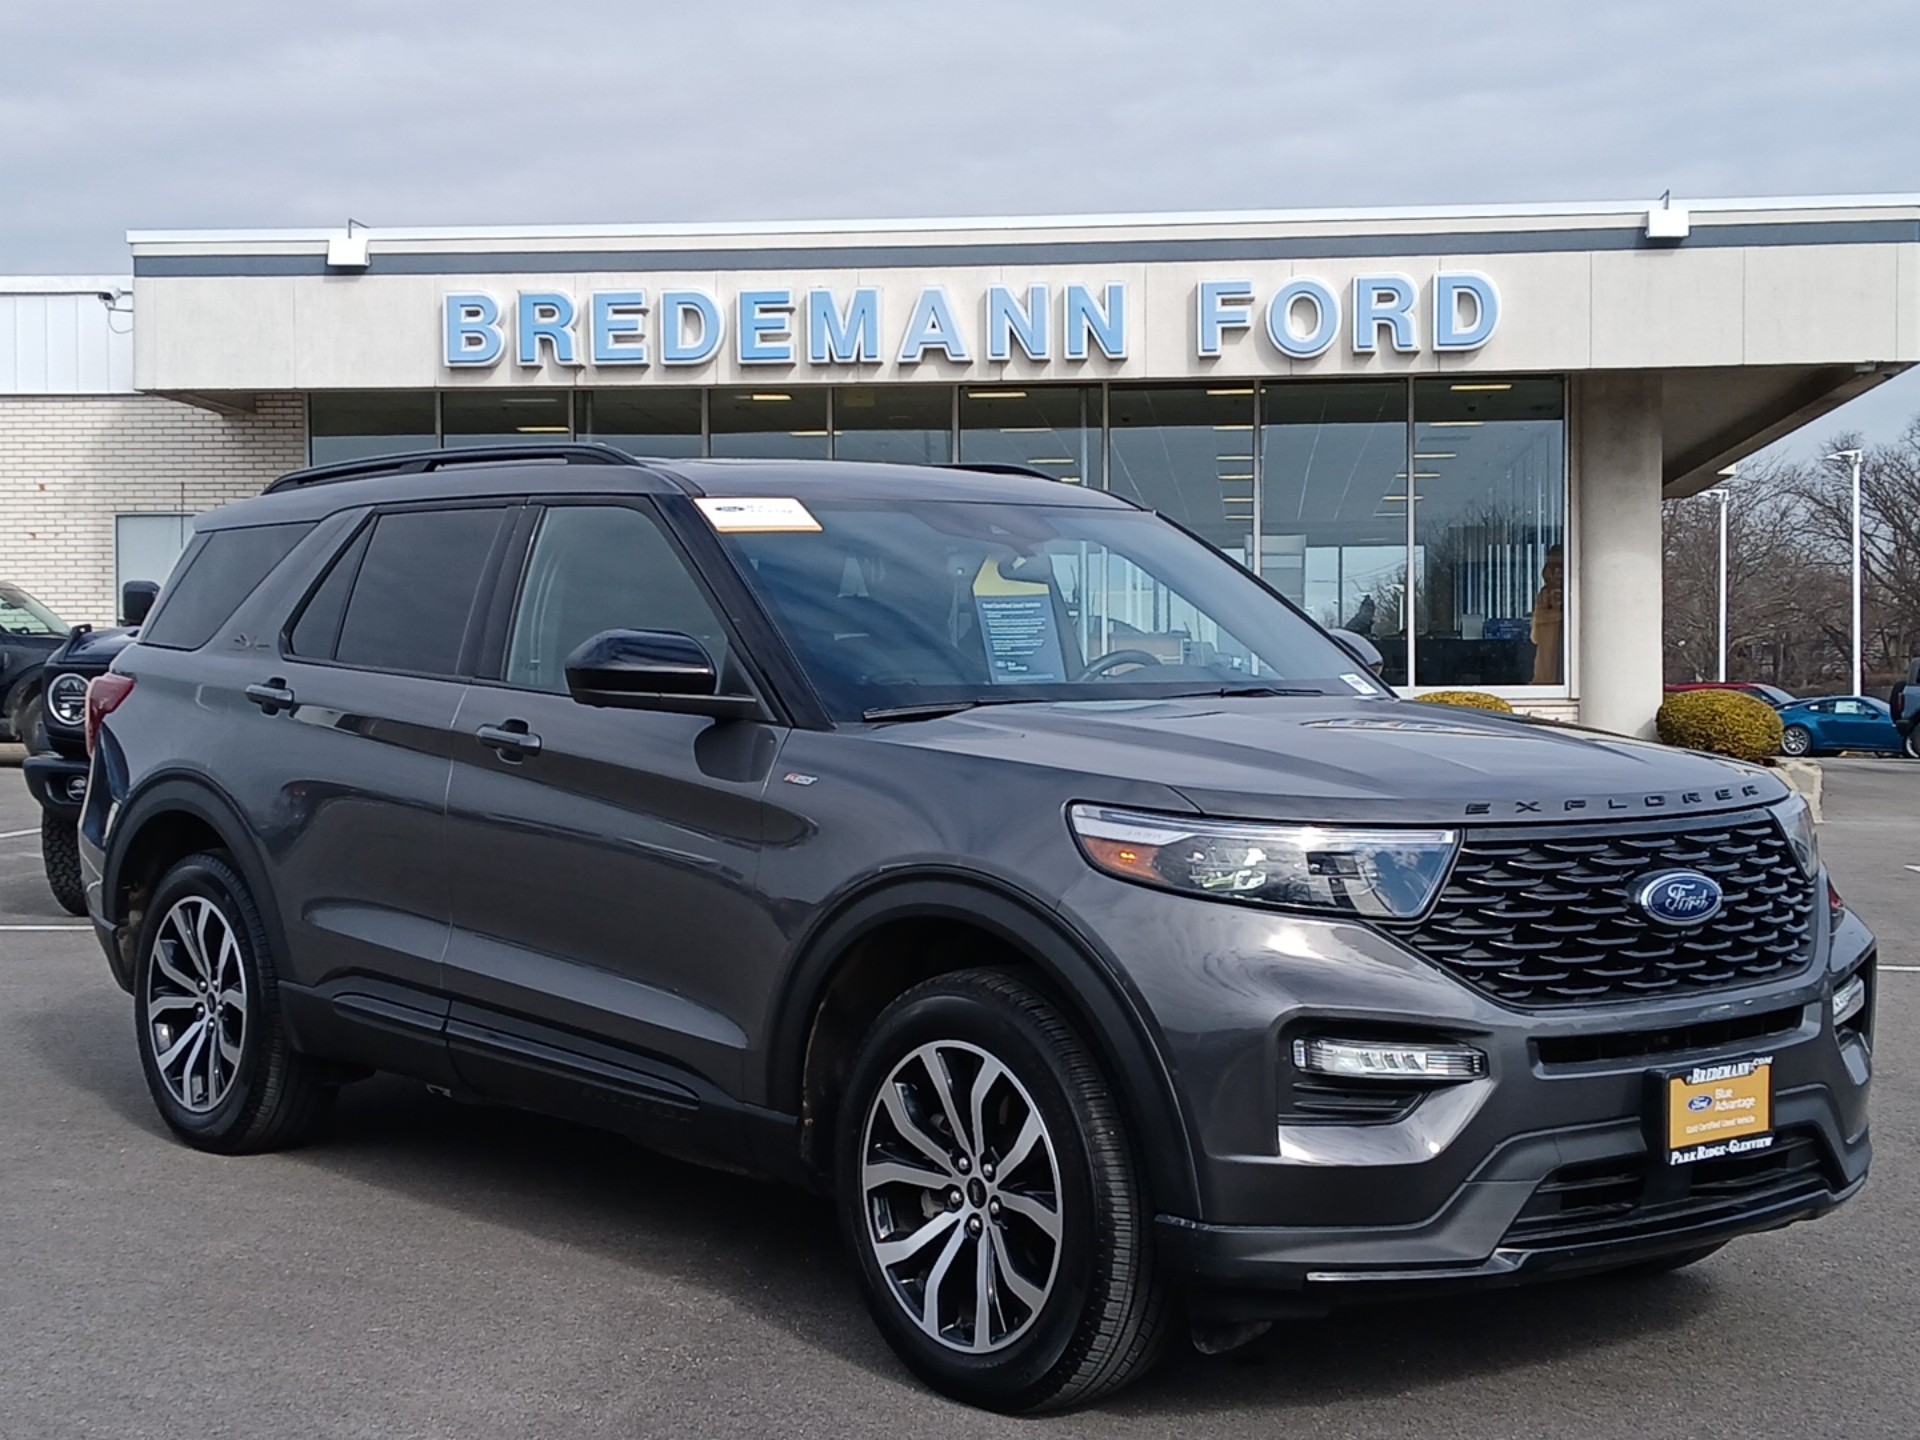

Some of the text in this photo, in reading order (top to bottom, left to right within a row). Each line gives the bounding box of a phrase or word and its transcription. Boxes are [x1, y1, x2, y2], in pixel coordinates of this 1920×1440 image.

[441, 269, 1502, 369] BREDEMANN FORD
[1464, 784, 1761, 816] EXPLORER
[1664, 883, 1709, 912] Ford
[1714, 1088, 1733, 1099] Blue
[1714, 1097, 1756, 1112] Advantage
[1670, 1151, 1696, 1166] PARK
